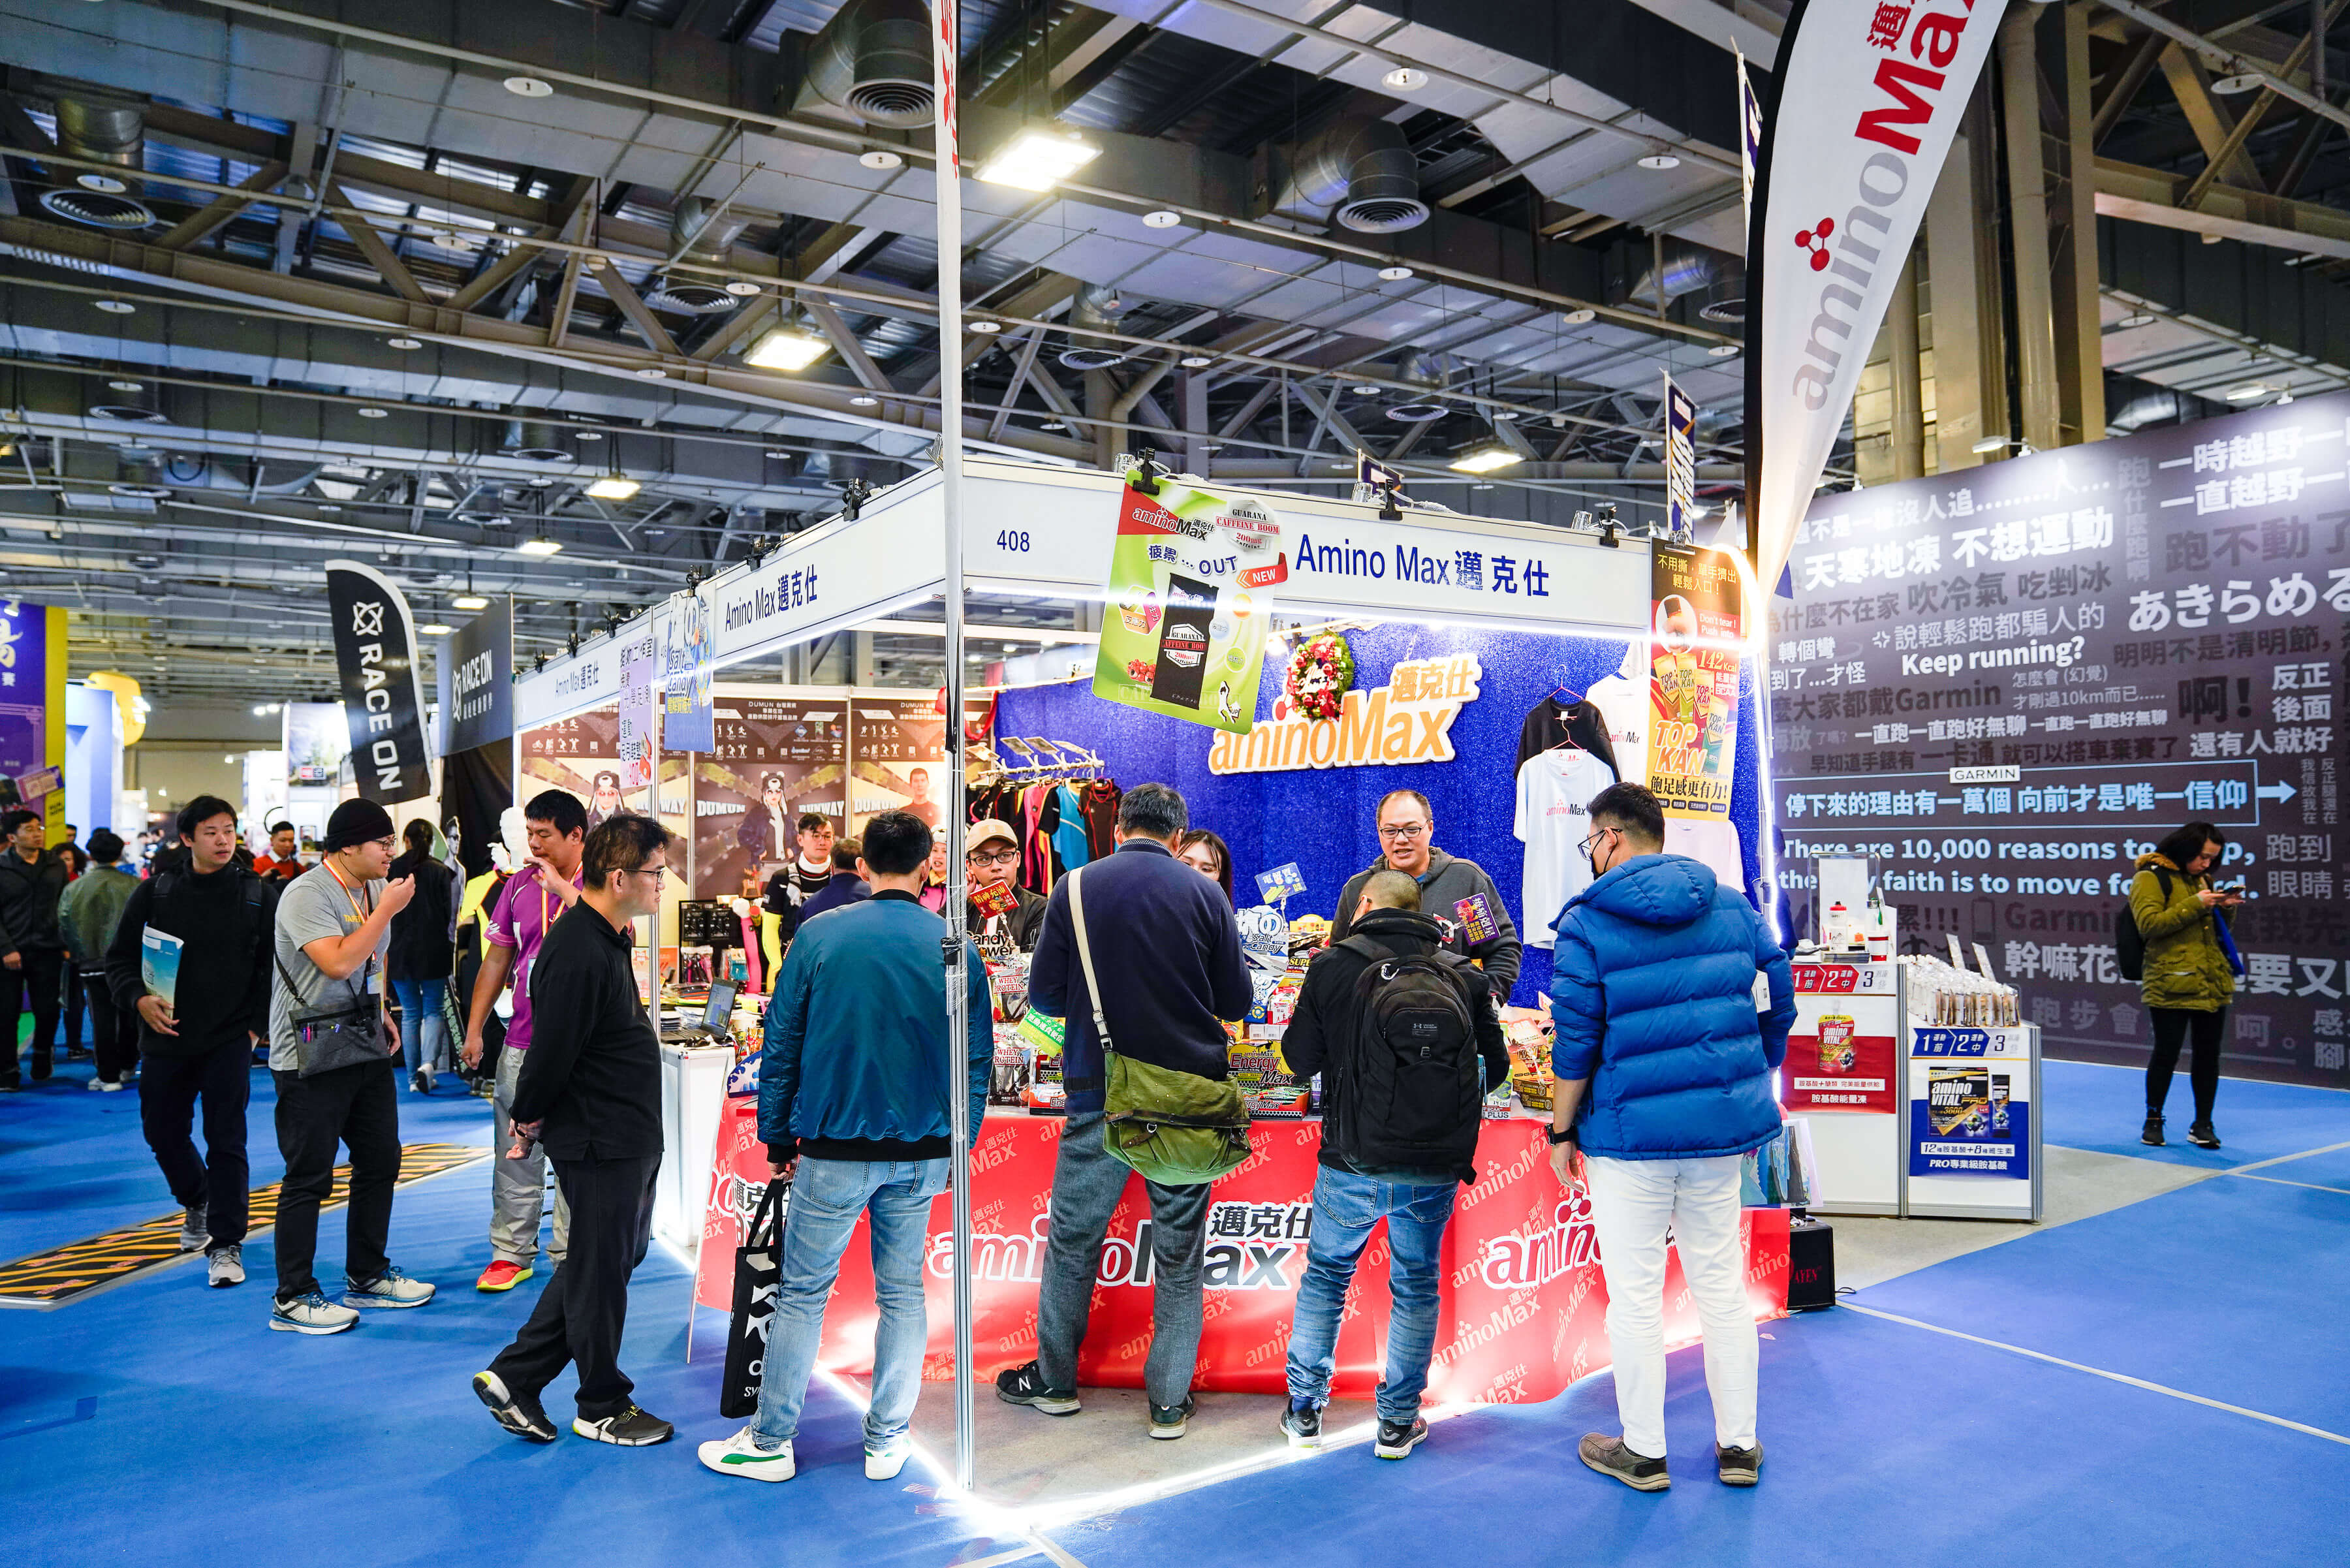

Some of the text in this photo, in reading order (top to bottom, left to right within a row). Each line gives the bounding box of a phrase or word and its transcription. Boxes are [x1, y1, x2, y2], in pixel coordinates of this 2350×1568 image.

[1793, 0, 1975, 411] aminoMa
[2159, 416, 2350, 473] 一時越野一
[2160, 460, 2350, 516] 一直越野一
[1132, 507, 1208, 542] aminoMax
[1192, 518, 1216, 533] 邁克仕
[1216, 516, 1280, 534] CAFFEINE BOOM
[1232, 508, 1268, 522] GUARANA
[997, 529, 1030, 552] 408
[1236, 532, 1262, 544] 200mg
[1804, 535, 1941, 591] 天寒地凍
[1952, 506, 2113, 569] 不想運動
[1149, 544, 1238, 576] 疲累 OUT
[1295, 533, 1550, 597] Amino Max 邁克仕
[1252, 569, 1276, 584] NEW
[725, 596, 753, 633] Amino
[755, 587, 776, 623] Max
[777, 564, 817, 612] 邁克仕
[1908, 571, 2008, 616] 吹冷氣
[1701, 625, 1734, 638] Push into
[1895, 601, 2105, 651] 說輕鬆跑都騙人的
[669, 649, 685, 673] Salt
[1699, 650, 1737, 672] 142 Kcal
[1778, 636, 1836, 664] 轉個彎
[1902, 636, 2085, 676] Keep running?
[462, 649, 493, 695] RACE ON
[1390, 659, 1474, 704] 邁克仕
[1661, 672, 1673, 685] TOP
[1680, 669, 1692, 678] TOP
[2013, 670, 2058, 687] 怎麼會
[2272, 662, 2332, 691] 反正
[667, 674, 694, 698] Candy
[1697, 685, 1709, 693] TOP
[358, 643, 403, 791] RACE ON
[1709, 712, 1722, 722] TOP
[2272, 694, 2332, 723] 後面
[1211, 691, 1451, 771] aminoMax
[1654, 720, 1697, 749] TOP
[1708, 722, 1724, 734] KAN
[1855, 715, 2026, 745] 一直跑一直跑好無聊
[2190, 726, 2334, 759] 還有人就好
[1655, 747, 1708, 776] KAN
[1954, 768, 2016, 781] GARMIN
[697, 800, 845, 817] DUMUN RUNWAY
[854, 799, 899, 815] DUMUN
[1546, 802, 1586, 816] aminoMax
[1786, 779, 2248, 818] 停下來的理由有一萬個 向前才是唯一信仰
[1902, 839, 1991, 863] 10,000
[1998, 839, 2121, 860] reasons
[2123, 838, 2157, 860] to
[2266, 834, 2331, 862] 跑到
[1779, 870, 1817, 890] the
[1883, 870, 1946, 892] faith
[1952, 870, 1974, 894] is
[1981, 873, 2010, 894] to
[2016, 877, 2101, 896] move
[2268, 870, 2333, 900] 眼睛
[2004, 902, 2112, 933] Garmi
[1251, 942, 1283, 954] Candy
[1253, 933, 1273, 943] Salt
[2005, 941, 2142, 984] 幹嘛花
[994, 983, 1024, 992] PROTEIN
[1826, 971, 1838, 988] 2
[1863, 971, 1874, 987] 3
[1841, 980, 1850, 988] 中
[1823, 1026, 1848, 1036] amino
[2313, 1009, 2350, 1037] 感
[1823, 1036, 1841, 1044] VITAL
[1922, 1035, 1930, 1052] 1
[1956, 1035, 1967, 1052] 2
[1994, 1035, 2005, 1052] 3
[1971, 1044, 1979, 1052] 中
[1230, 1053, 1280, 1073] Energy
[1259, 1069, 1296, 1085] Max
[1931, 1080, 1973, 1094] amino
[1931, 1094, 1962, 1106] VITAL
[984, 1126, 1018, 1152] 邁克仕
[972, 1199, 1005, 1223] 邁克仕
[1210, 1204, 1312, 1239] 邁克仕
[1432, 1293, 1541, 1368] aminoMax
[1493, 1362, 1528, 1390] 邁克仕
